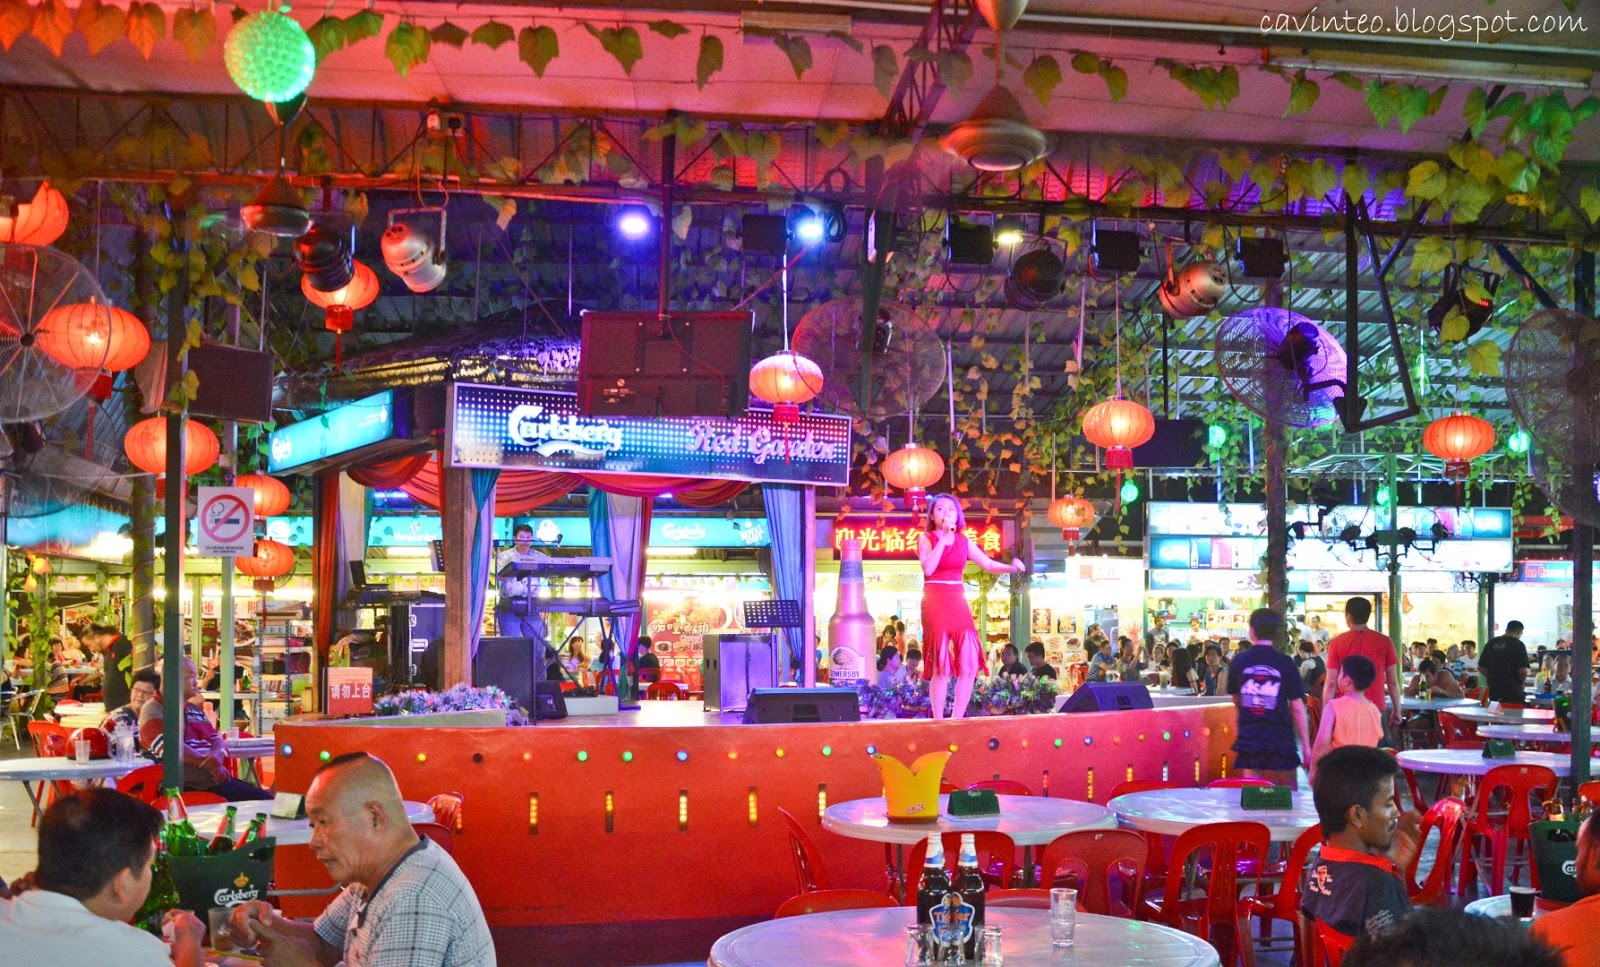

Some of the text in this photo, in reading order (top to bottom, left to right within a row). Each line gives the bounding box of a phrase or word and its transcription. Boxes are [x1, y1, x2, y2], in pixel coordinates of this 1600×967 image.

[508, 404, 622, 452] Carlsberg
[685, 422, 835, 464] Red Garden
[331, 683, 371, 699] 请勿上台
[213, 885, 259, 906] Carlsberg
